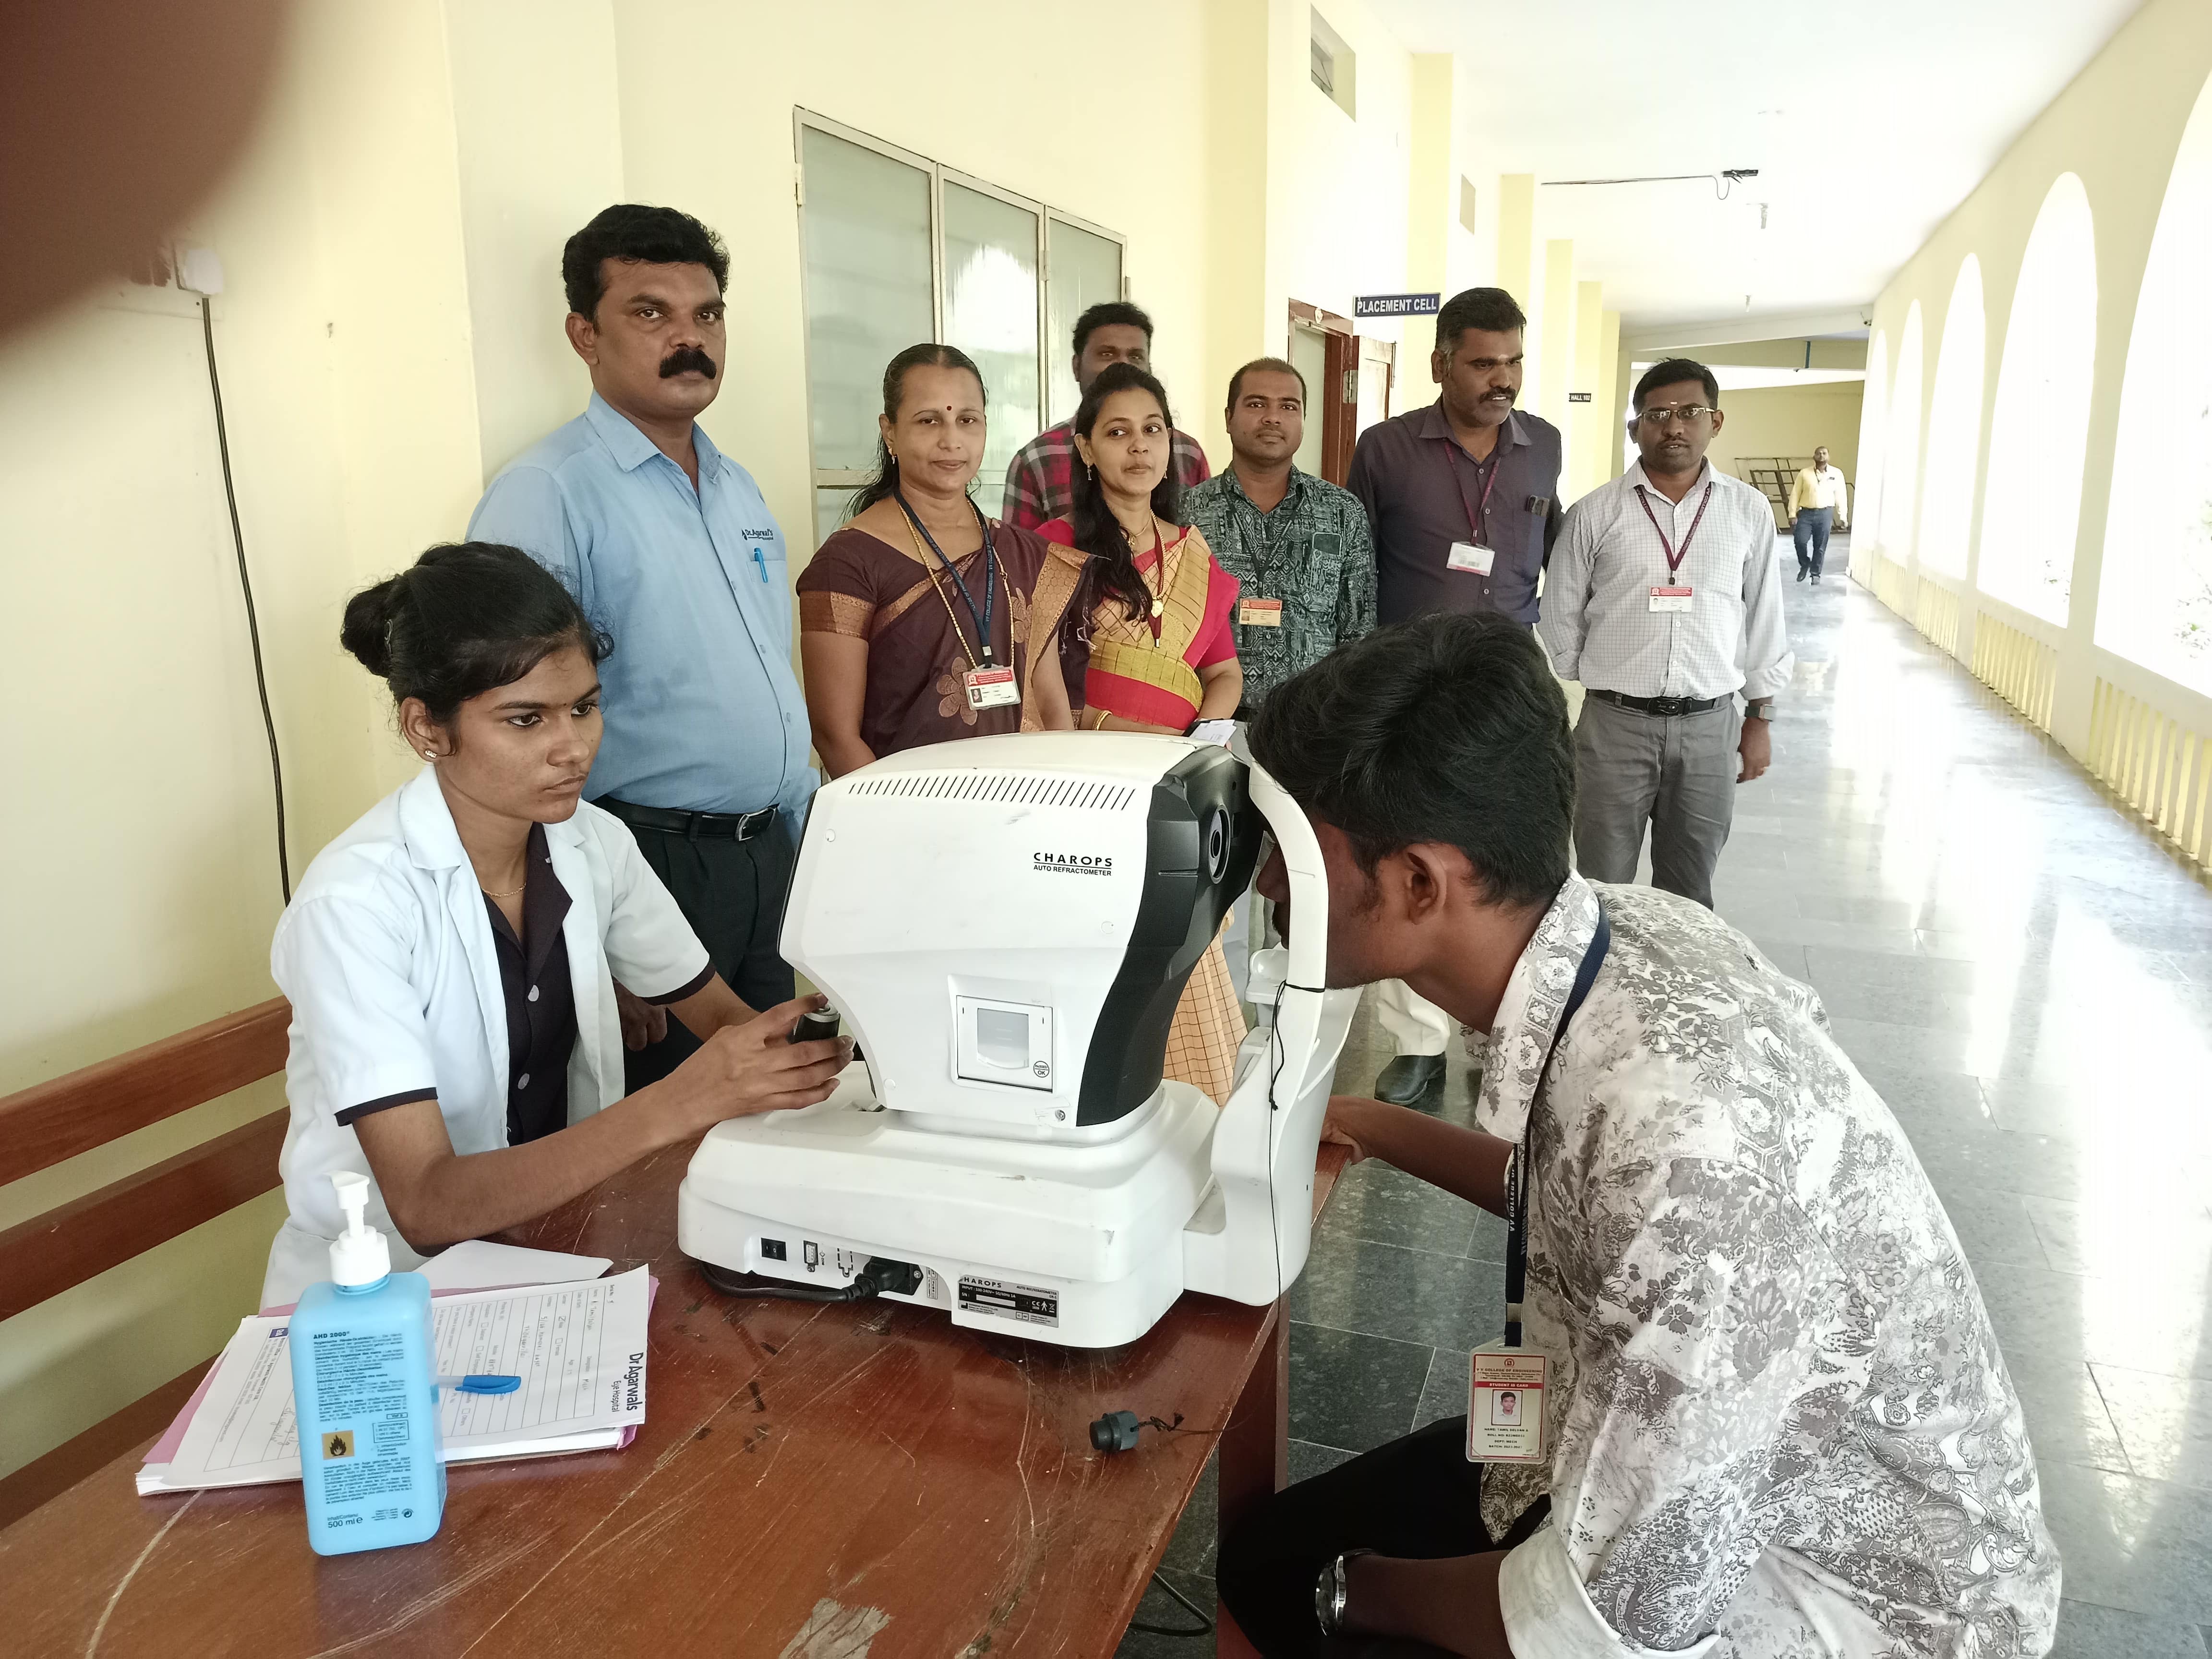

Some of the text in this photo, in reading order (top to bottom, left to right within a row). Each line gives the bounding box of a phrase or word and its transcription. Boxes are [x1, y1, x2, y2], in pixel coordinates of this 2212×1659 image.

[1357, 298, 1437, 313] PLACEMENT CELL
[1034, 852, 1112, 867] CHAROPS
[1053, 866, 1111, 876] REFRACTOMETER
[1510, 1219, 1515, 1231] VV
[964, 1276, 1002, 1288] HAROPS
[624, 1352, 644, 1411] Dr Agarwals
[611, 1381, 621, 1412] Eye Hospital
[328, 1520, 343, 1528] 500
